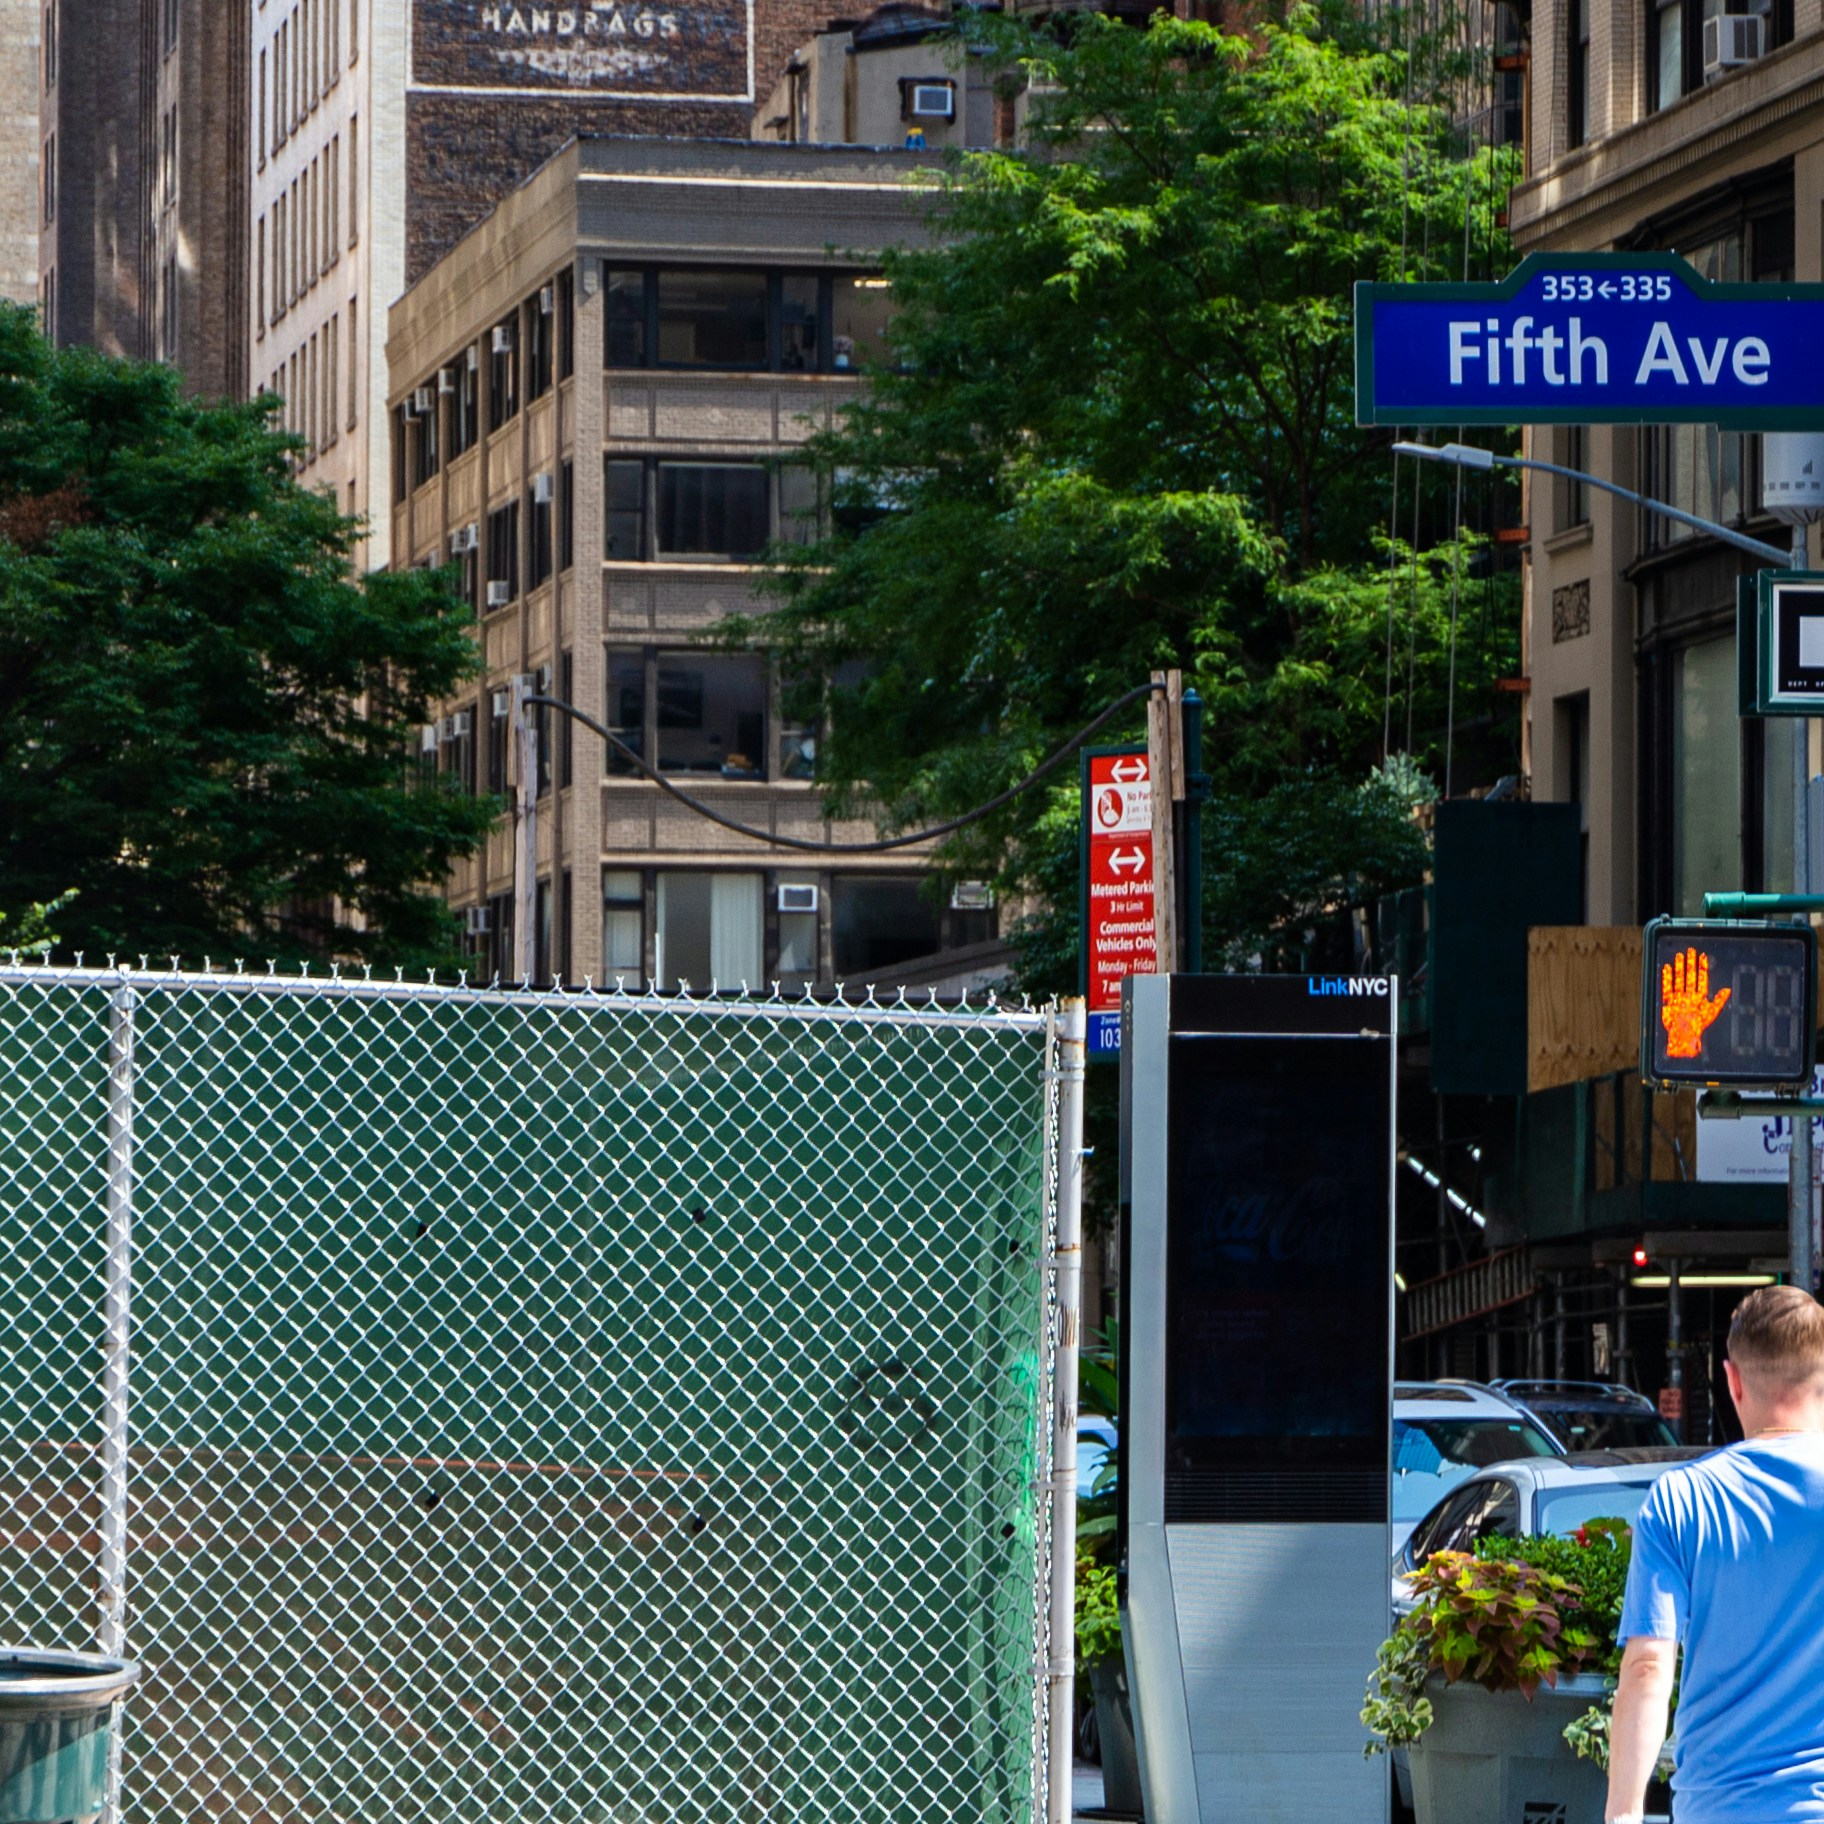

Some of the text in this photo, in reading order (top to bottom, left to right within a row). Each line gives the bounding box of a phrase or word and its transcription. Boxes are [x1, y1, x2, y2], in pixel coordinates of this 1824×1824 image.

[482, 6, 680, 38] HANDBAGS
[1447, 316, 1771, 386] Fifth Ave
[1091, 881, 1129, 897] Metered
[1110, 901, 1116, 914] 3
[1126, 900, 1144, 913] Limit
[1100, 919, 1154, 936] Commercial
[1096, 935, 1156, 953] Vehicles Only
[1098, 959, 1128, 975] Monday
[1133, 957, 1156, 973] Friday
[1103, 980, 1109, 994] 7
[1308, 976, 1389, 996] LinkNYC
